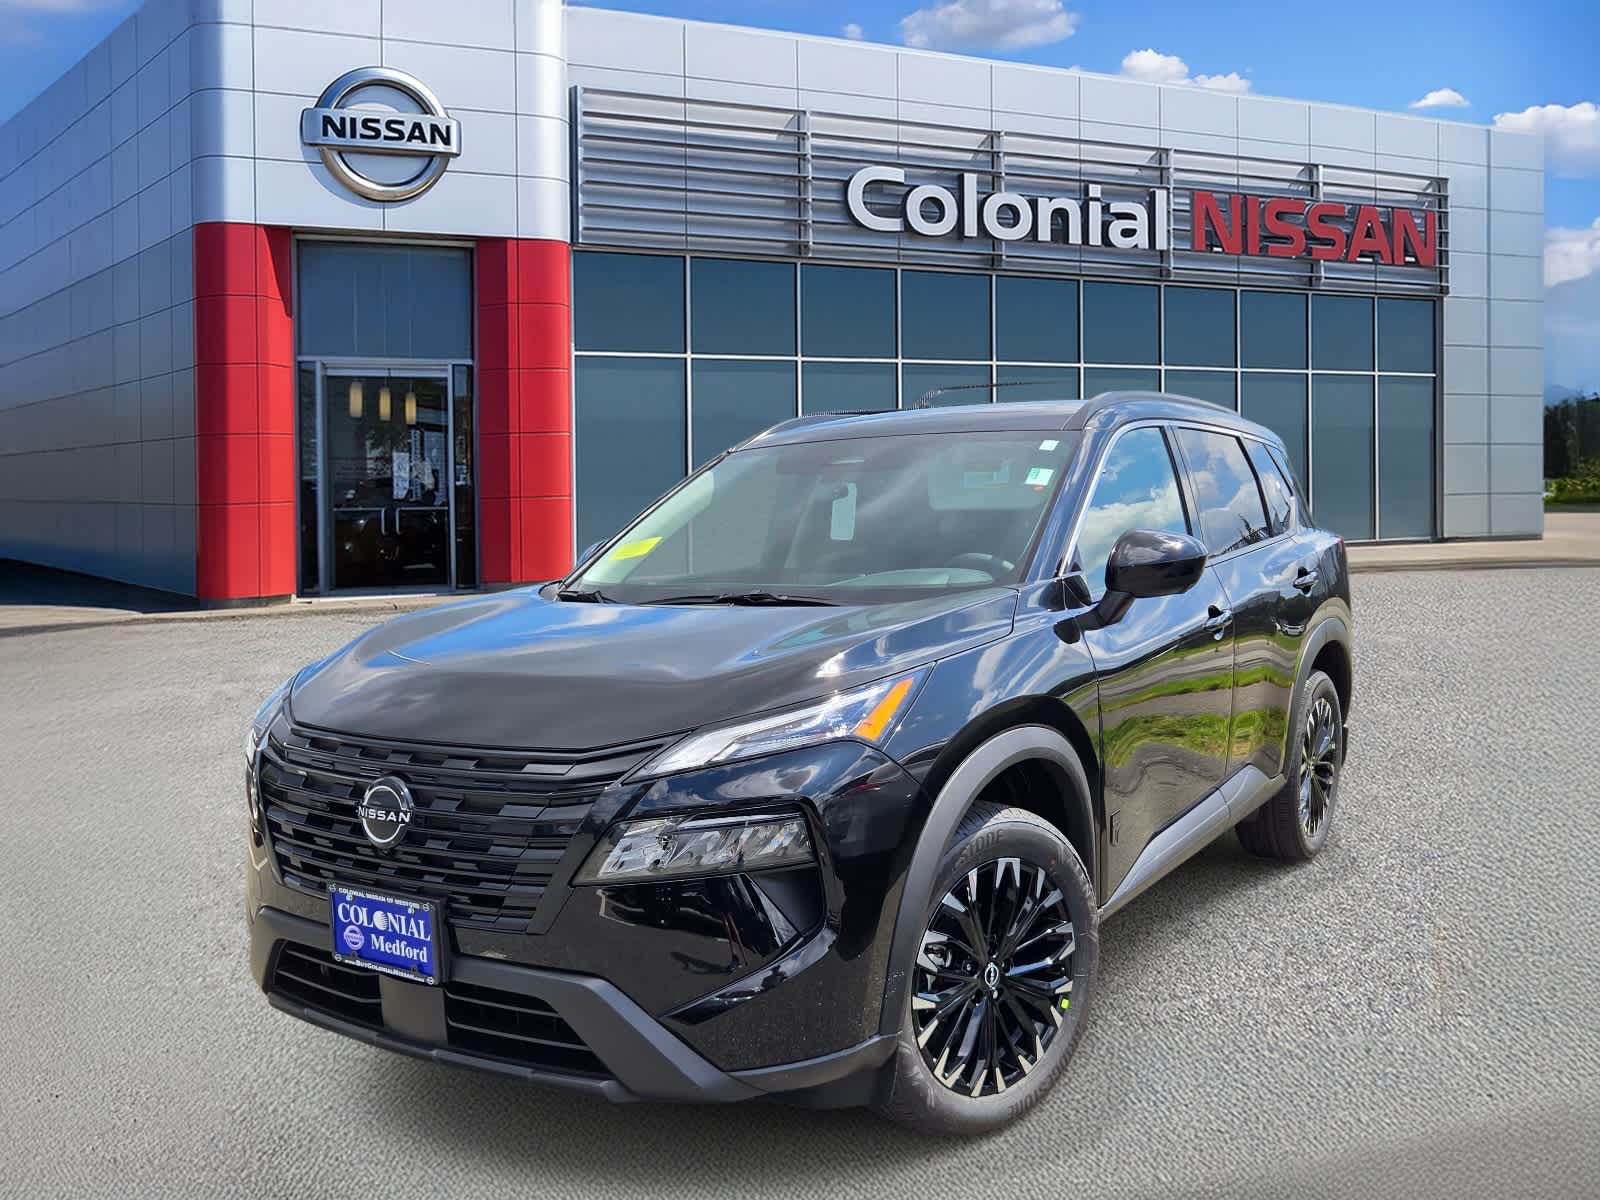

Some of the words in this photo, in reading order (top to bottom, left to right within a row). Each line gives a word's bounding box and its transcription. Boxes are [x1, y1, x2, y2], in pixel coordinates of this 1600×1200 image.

[322, 115, 451, 146] NISSAN
[847, 166, 1168, 250] Colonial
[1192, 191, 1436, 267] NISSAN
[358, 806, 410, 822] NISSAN
[338, 903, 431, 941] COLONIAL
[370, 934, 428, 963] Medford
